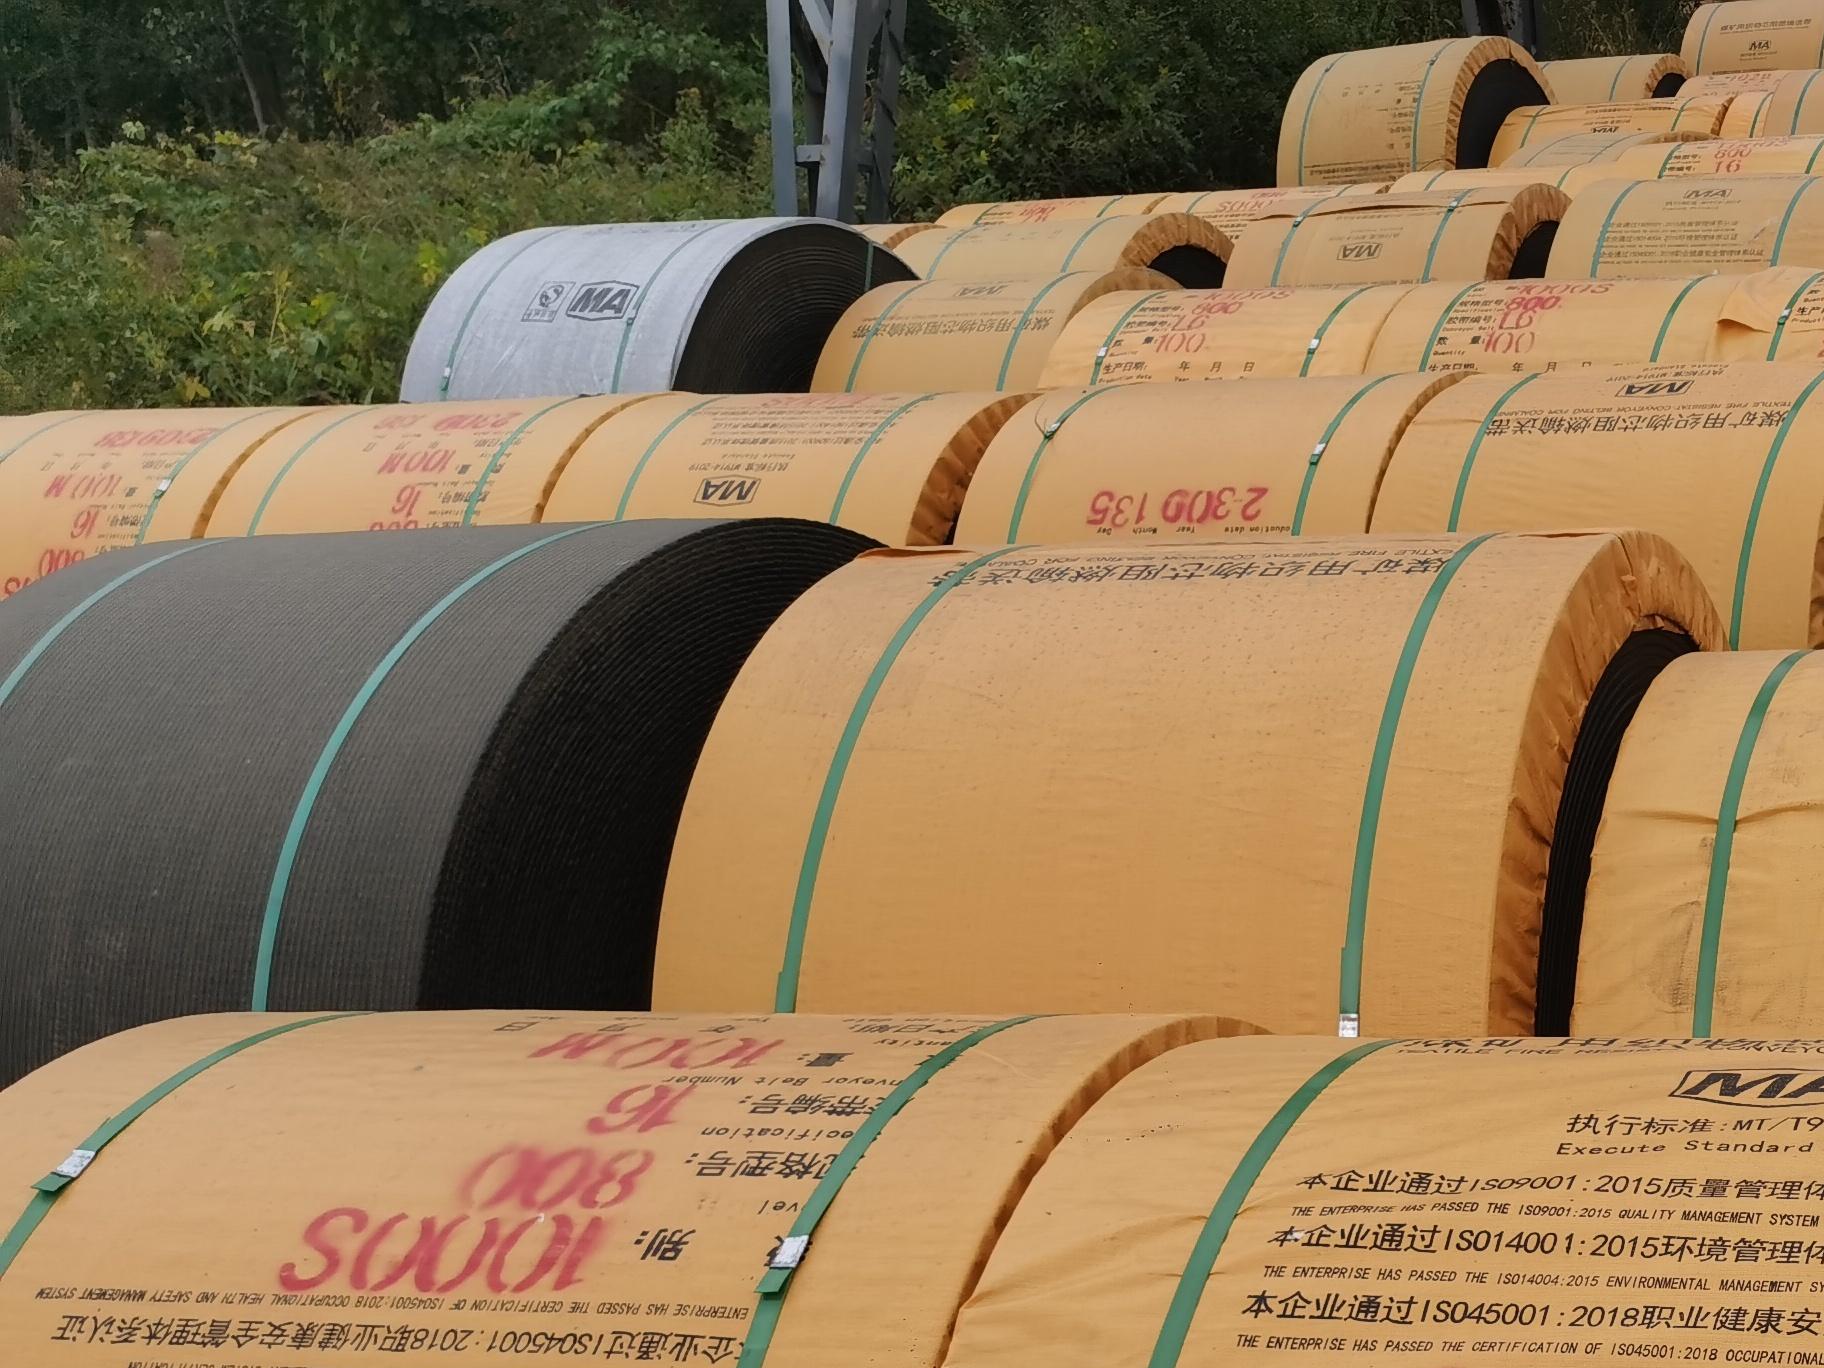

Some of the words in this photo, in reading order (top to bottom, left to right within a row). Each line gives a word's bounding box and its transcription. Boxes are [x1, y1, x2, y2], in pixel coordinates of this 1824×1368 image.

[391, 483, 422, 518] 16
[70, 510, 100, 539] 16
[527, 1033, 784, 1070] 100M
[586, 1083, 700, 1137] 16
[1556, 1140, 1666, 1155] Execute
[1684, 1139, 1816, 1154] Standard
[455, 1144, 656, 1211] 800
[1290, 1206, 1313, 1218] THE
[1430, 1201, 1479, 1214] PASSED
[1486, 1202, 1511, 1215] THE
[1518, 1203, 1612, 1219] ISO9001:2015
[1618, 1208, 1676, 1222] QUALITY
[1681, 1209, 1762, 1225] MANAGEMENT
[1769, 1213, 1820, 1228] SYSTEM
[278, 1207, 618, 1295] 1000S
[634, 1227, 697, 1263] 别:
[1292, 1265, 1372, 1281] ENTERPRISE
[1408, 1268, 1457, 1283] PASSED
[1497, 1272, 1600, 1288] ISO14004:2015
[1606, 1275, 1711, 1292] ENVIRONMENTAL
[1719, 1278, 1803, 1294] MANAGEMENT
[51, 1314, 743, 1364] 企业通过ISO45001:2018职业健康安全管理体系认证
[1236, 1334, 1259, 1348] THE
[1265, 1335, 1345, 1352] ENTERPRISE
[1352, 1338, 1378, 1353] HAS
[1384, 1338, 1434, 1354] PASSED
[1440, 1340, 1465, 1353] THE
[1471, 1340, 1579, 1355] CERTIFICATION
[1585, 1342, 1603, 1356] OF
[1610, 1343, 1718, 1362] ISO45001:2018
